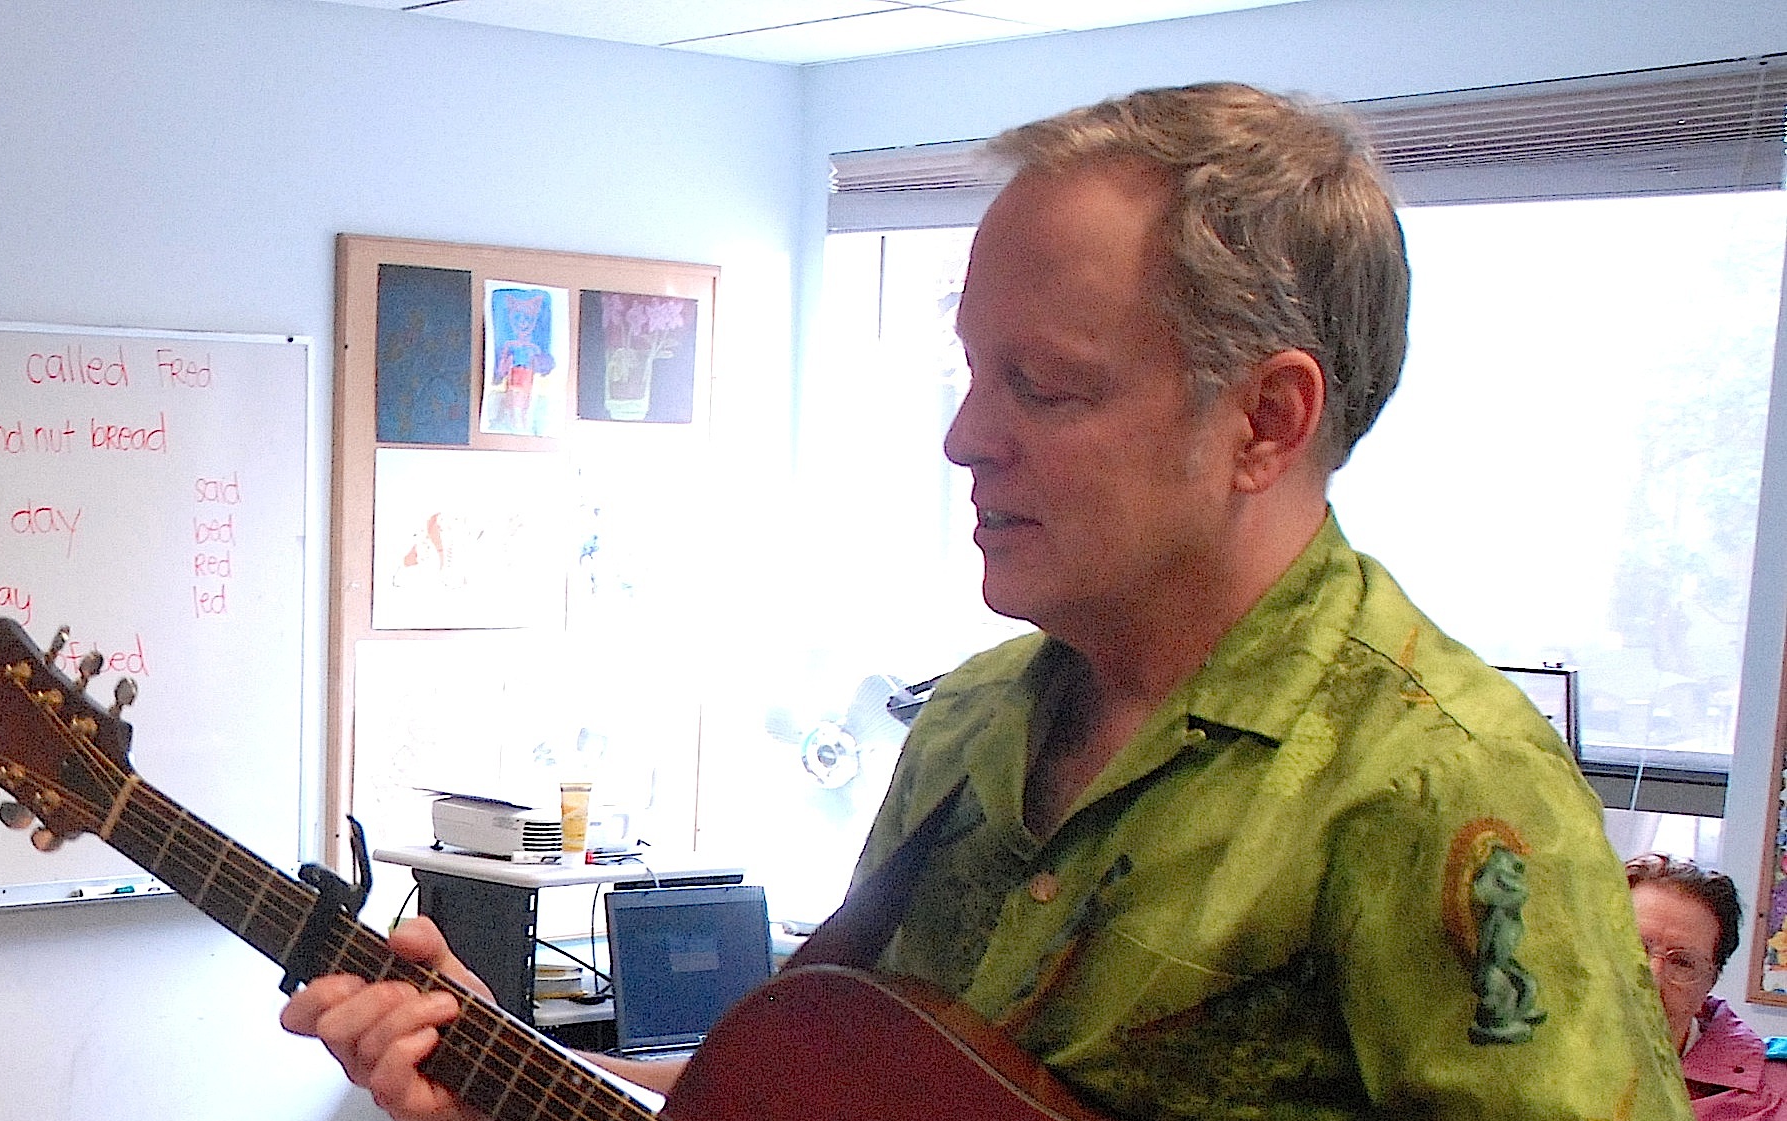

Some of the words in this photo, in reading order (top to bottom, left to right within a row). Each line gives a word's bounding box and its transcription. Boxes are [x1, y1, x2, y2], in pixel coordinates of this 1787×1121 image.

[26, 345, 129, 388] called
[34, 420, 76, 455] nut
[195, 471, 242, 505] said
[10, 499, 82, 560] day
